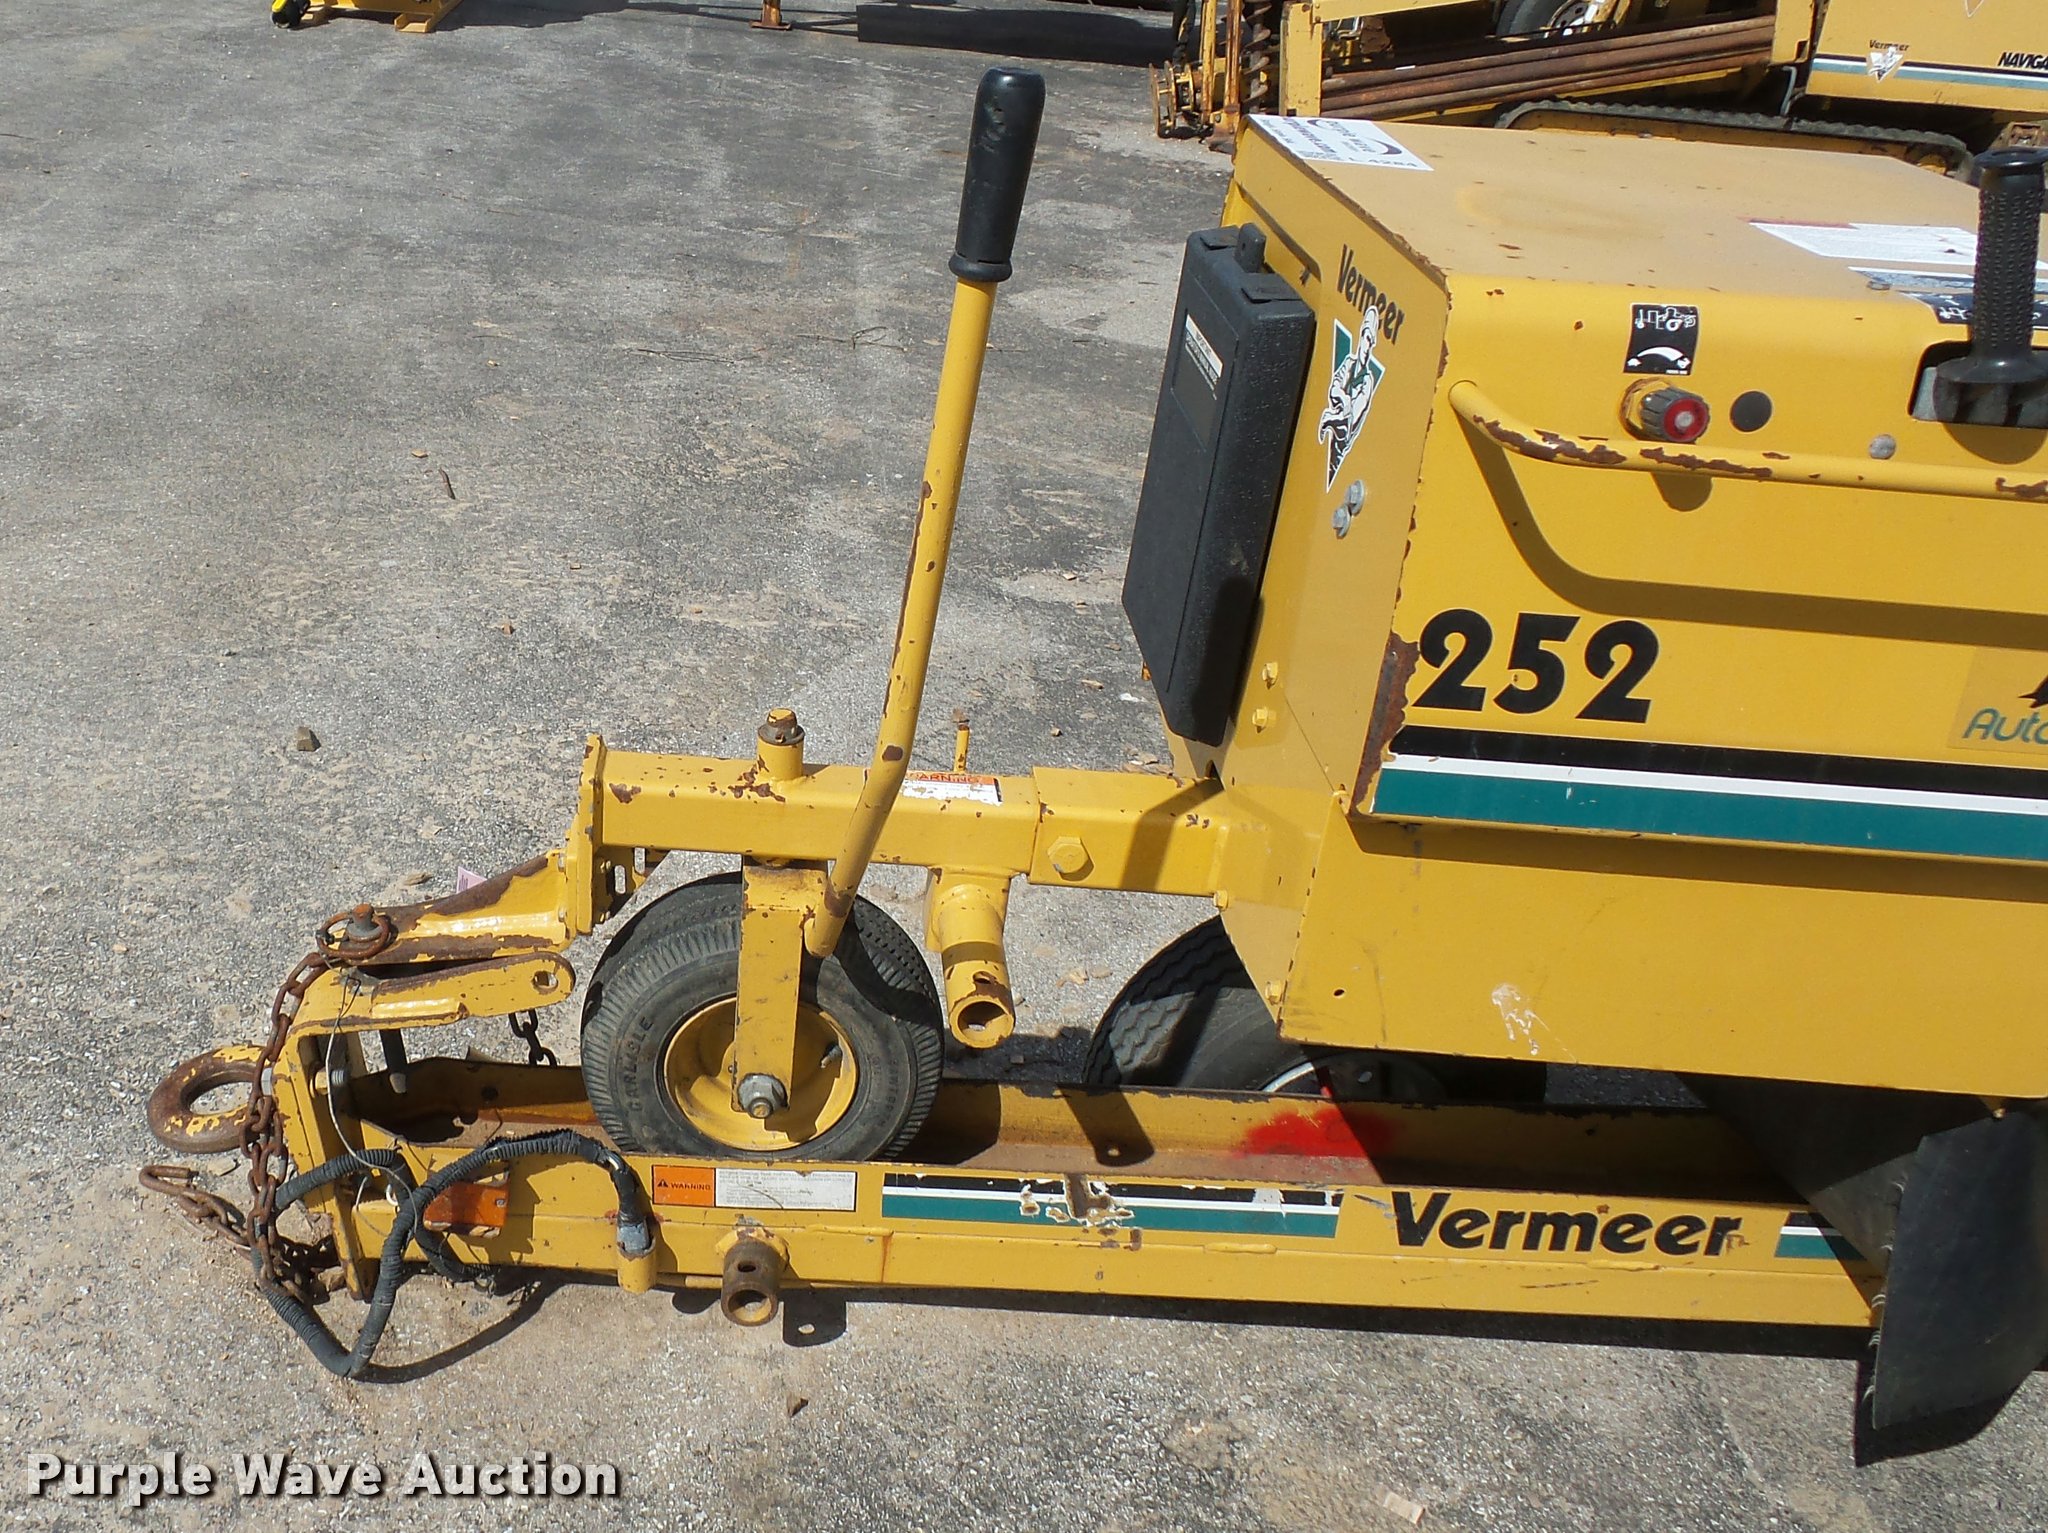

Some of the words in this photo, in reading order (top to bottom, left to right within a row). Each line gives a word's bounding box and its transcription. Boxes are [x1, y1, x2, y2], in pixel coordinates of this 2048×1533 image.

[1336, 243, 1405, 346] Vermeer
[1411, 608, 1660, 724] 252
[670, 1182, 711, 1191] WARNING
[1391, 1190, 1744, 1257] Vermeer
